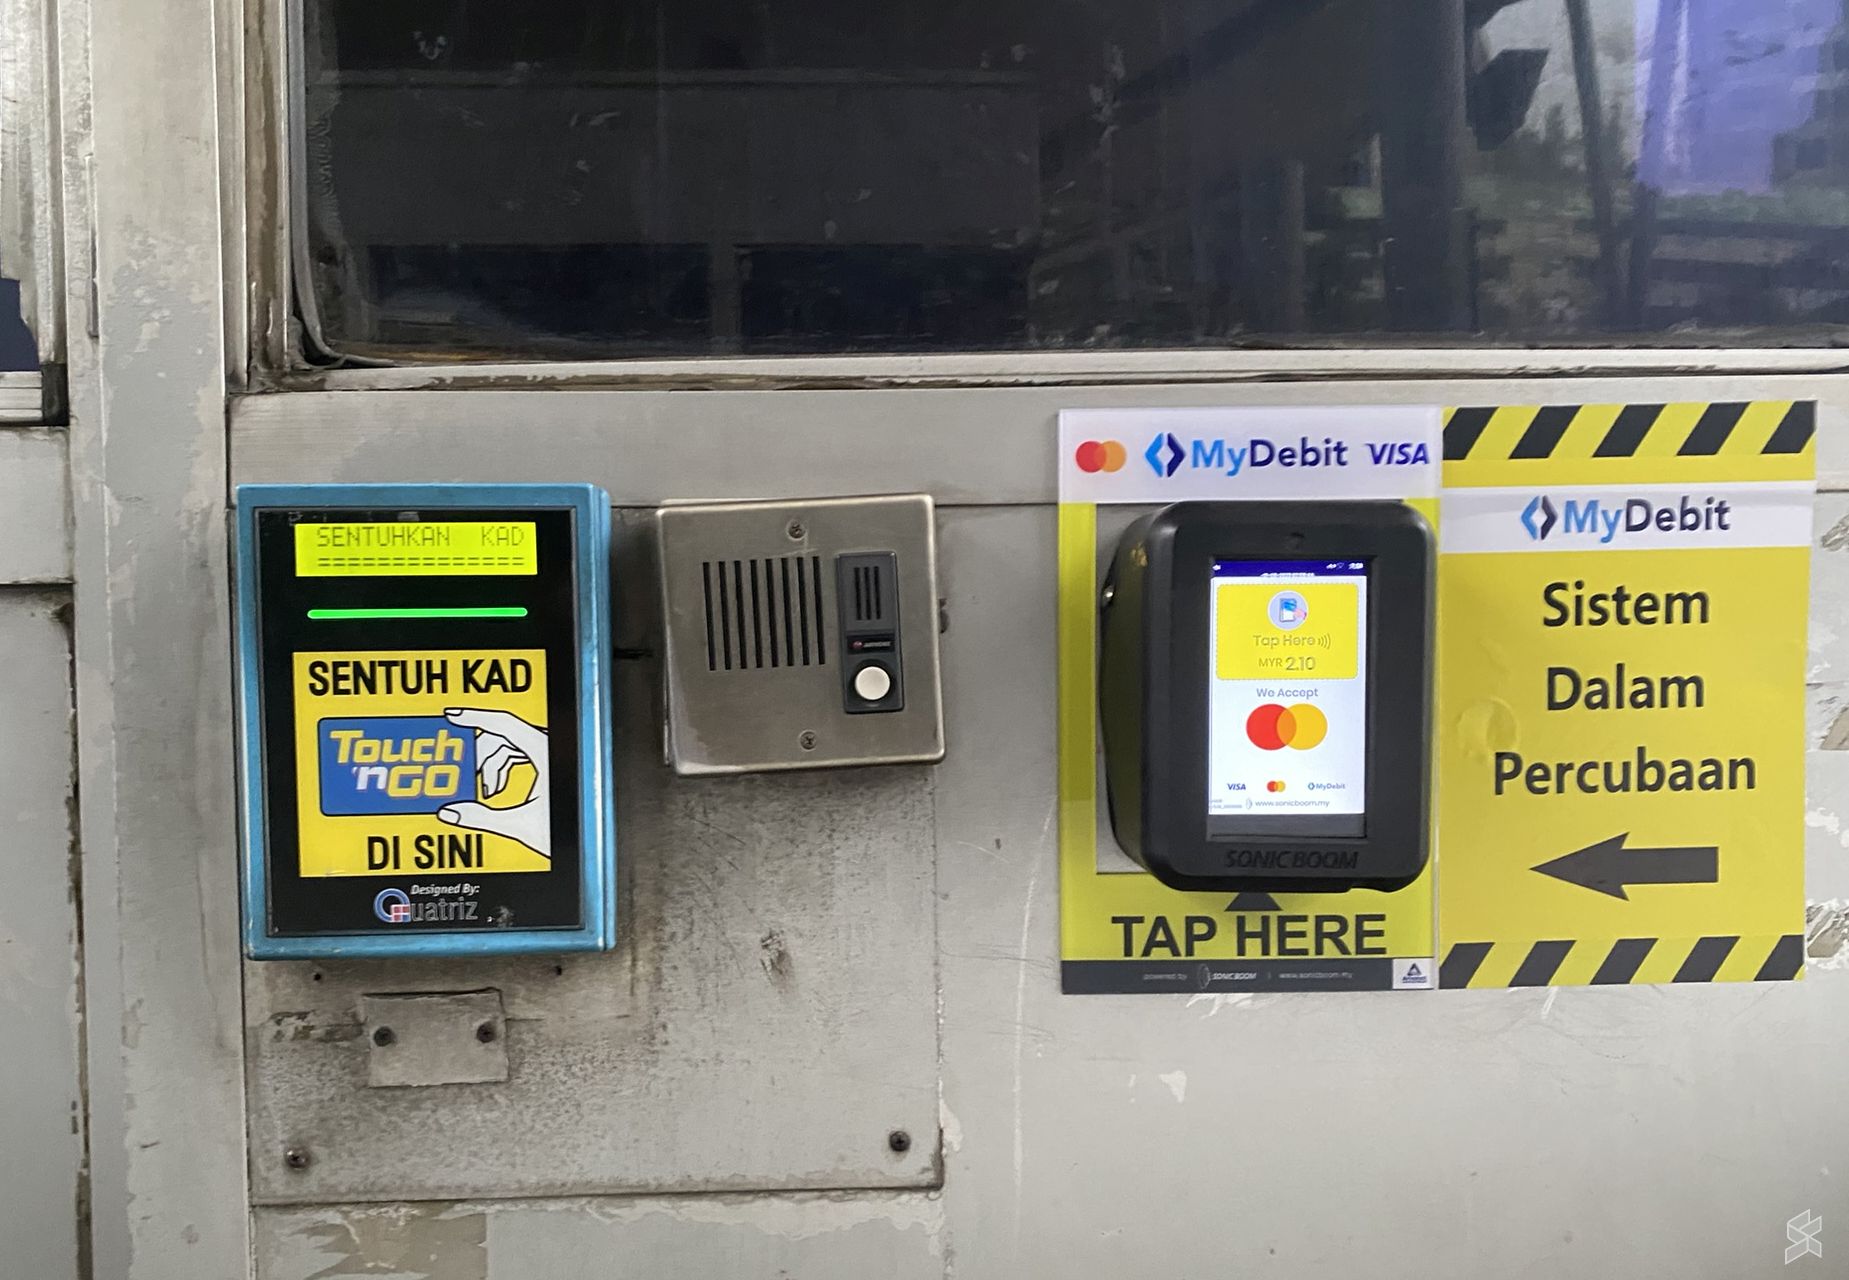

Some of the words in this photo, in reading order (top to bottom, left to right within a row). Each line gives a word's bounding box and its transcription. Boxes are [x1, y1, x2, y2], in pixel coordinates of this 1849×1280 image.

[1191, 436, 1349, 476] MyDebit
[1365, 443, 1430, 465] VISA
[317, 526, 451, 547] SENTUHKAN
[481, 526, 525, 547] KAD
[1563, 496, 1731, 543] MyDebit
[1542, 580, 1710, 627] Sistem
[1253, 635, 1279, 649] Tap
[1283, 635, 1316, 646] Here
[308, 659, 448, 697] SENTUH
[462, 658, 532, 694] KAD
[1258, 658, 1283, 667] MYR
[1285, 656, 1316, 671] 2.10
[1256, 688, 1275, 697] We
[1277, 688, 1318, 699] Accept
[1547, 664, 1706, 712] Dalam
[329, 730, 464, 764] Touch
[1227, 783, 1246, 791] VISA
[1494, 747, 1757, 797] Percubaan
[368, 836, 401, 871] DI
[414, 833, 485, 869] SINI
[411, 884, 460, 897] Designed
[462, 883, 480, 896] By:
[1111, 915, 1218, 957] TAP
[1236, 913, 1387, 957] HERE
